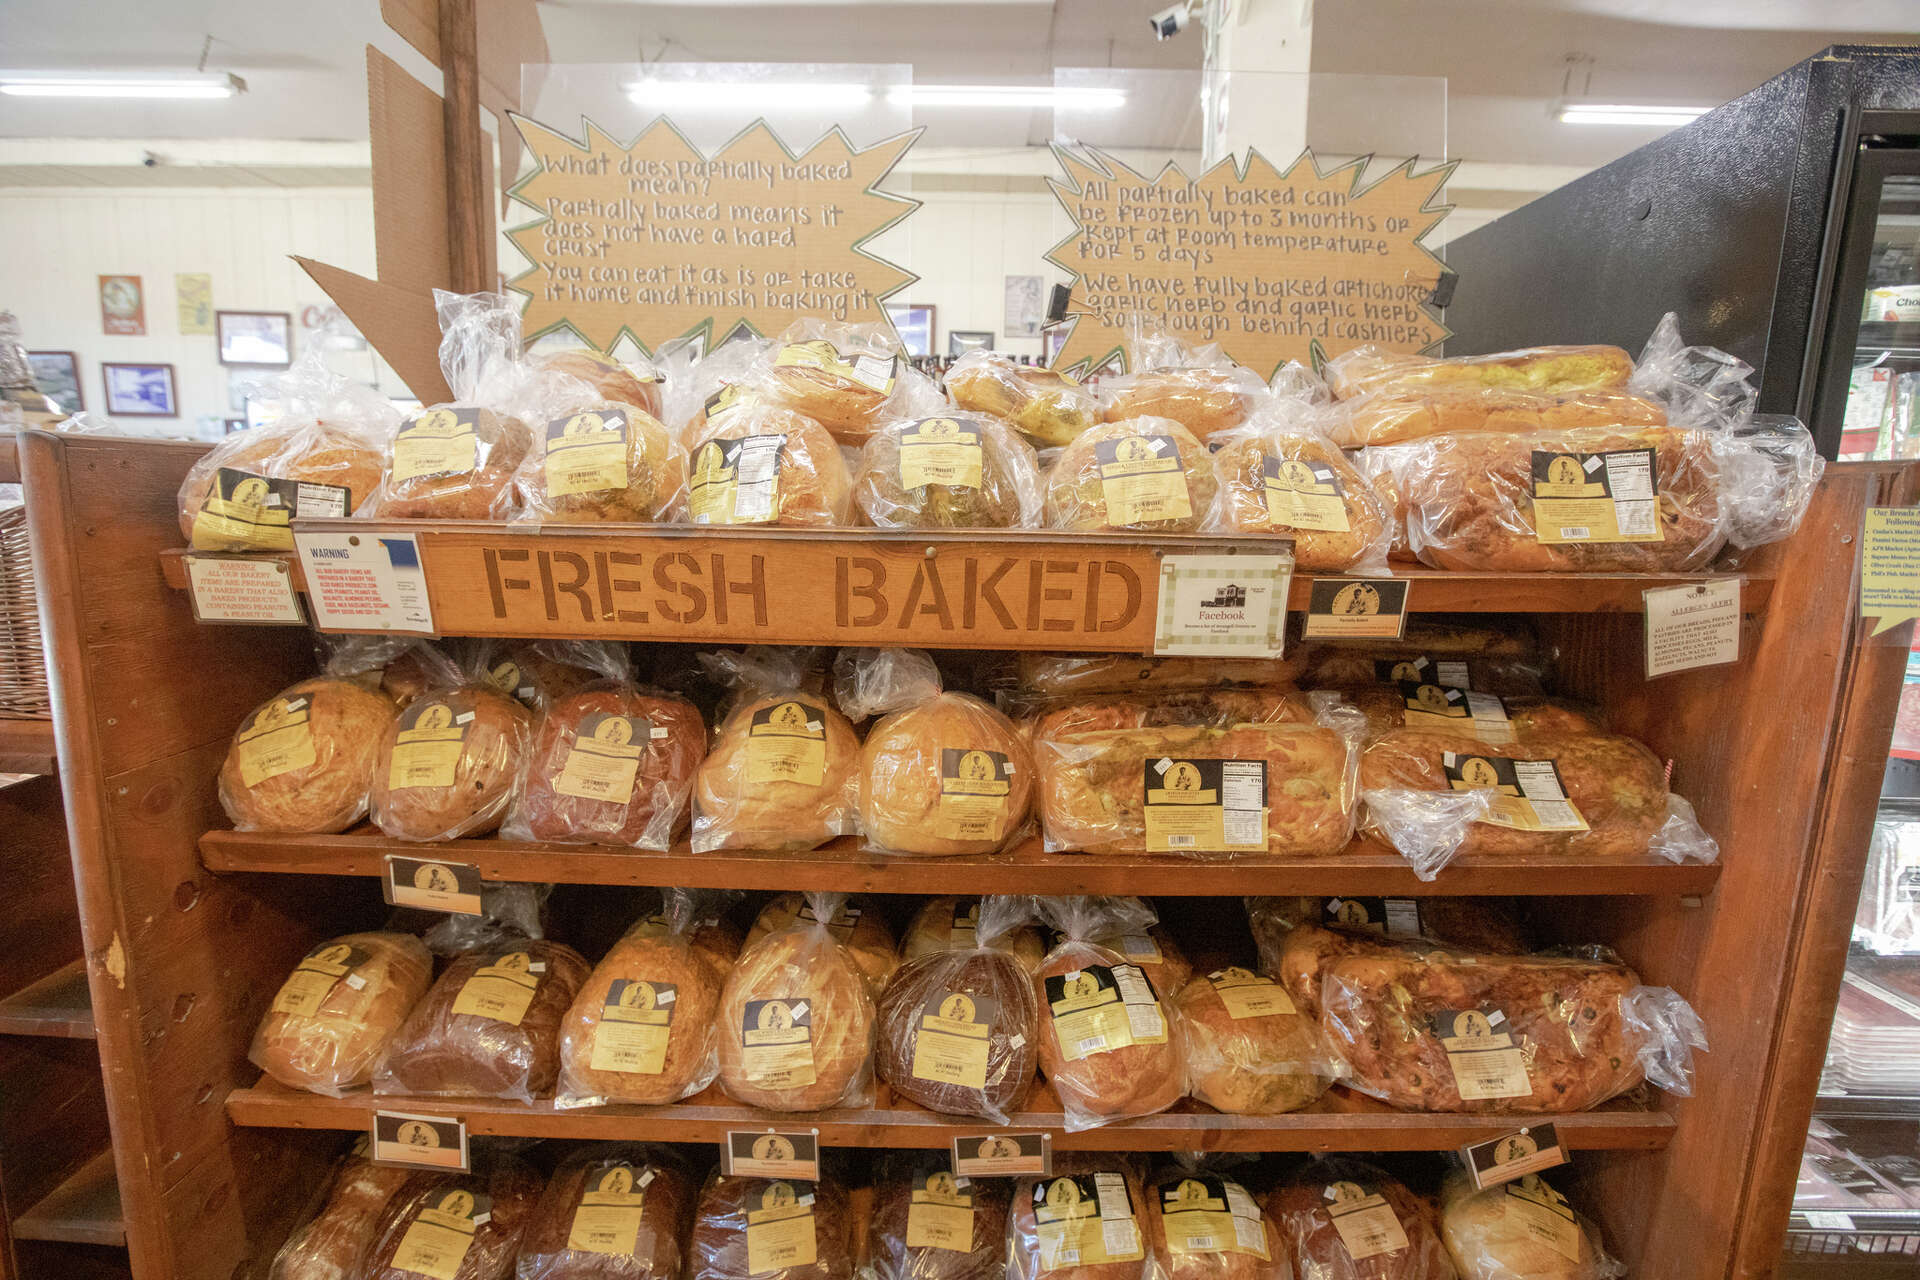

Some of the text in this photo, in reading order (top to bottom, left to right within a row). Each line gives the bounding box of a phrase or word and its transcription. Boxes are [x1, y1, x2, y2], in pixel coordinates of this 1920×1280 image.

[544, 153, 852, 189] What does partially baked
[628, 177, 711, 196] mean?
[1083, 181, 1347, 212] All partially baked can
[546, 197, 843, 227] Partially baked means it
[1078, 203, 1107, 222] be
[1208, 209, 1236, 231] up
[1240, 209, 1262, 227] to
[1270, 208, 1282, 227] 3
[1289, 211, 1376, 232] months
[542, 219, 796, 247] does not have a hard
[1145, 226, 1169, 244] at
[1243, 231, 1389, 255] temperature
[1133, 245, 1145, 261] 5
[1158, 245, 1213, 271] days
[542, 261, 582, 281] You
[589, 266, 629, 283] can
[634, 264, 674, 283] eat
[680, 264, 696, 283] it
[701, 267, 728, 285] as
[736, 264, 755, 286] is
[801, 269, 857, 289] take
[1083, 272, 1121, 293] We
[1126, 273, 1186, 295] have
[1193, 276, 1248, 302] fully
[1254, 276, 1327, 298] baked
[544, 282, 873, 321] it home and finish baking it
[1166, 295, 1226, 313] herb
[1235, 298, 1282, 315] and
[1289, 300, 1356, 319] garlic
[1364, 302, 1418, 322] herb
[1242, 315, 1329, 337] behind
[1336, 322, 1432, 345] cashiers
[311, 548, 350, 559] WARNING
[483, 548, 1141, 632] FRESH BAKED
[1199, 611, 1245, 620] Facebook
